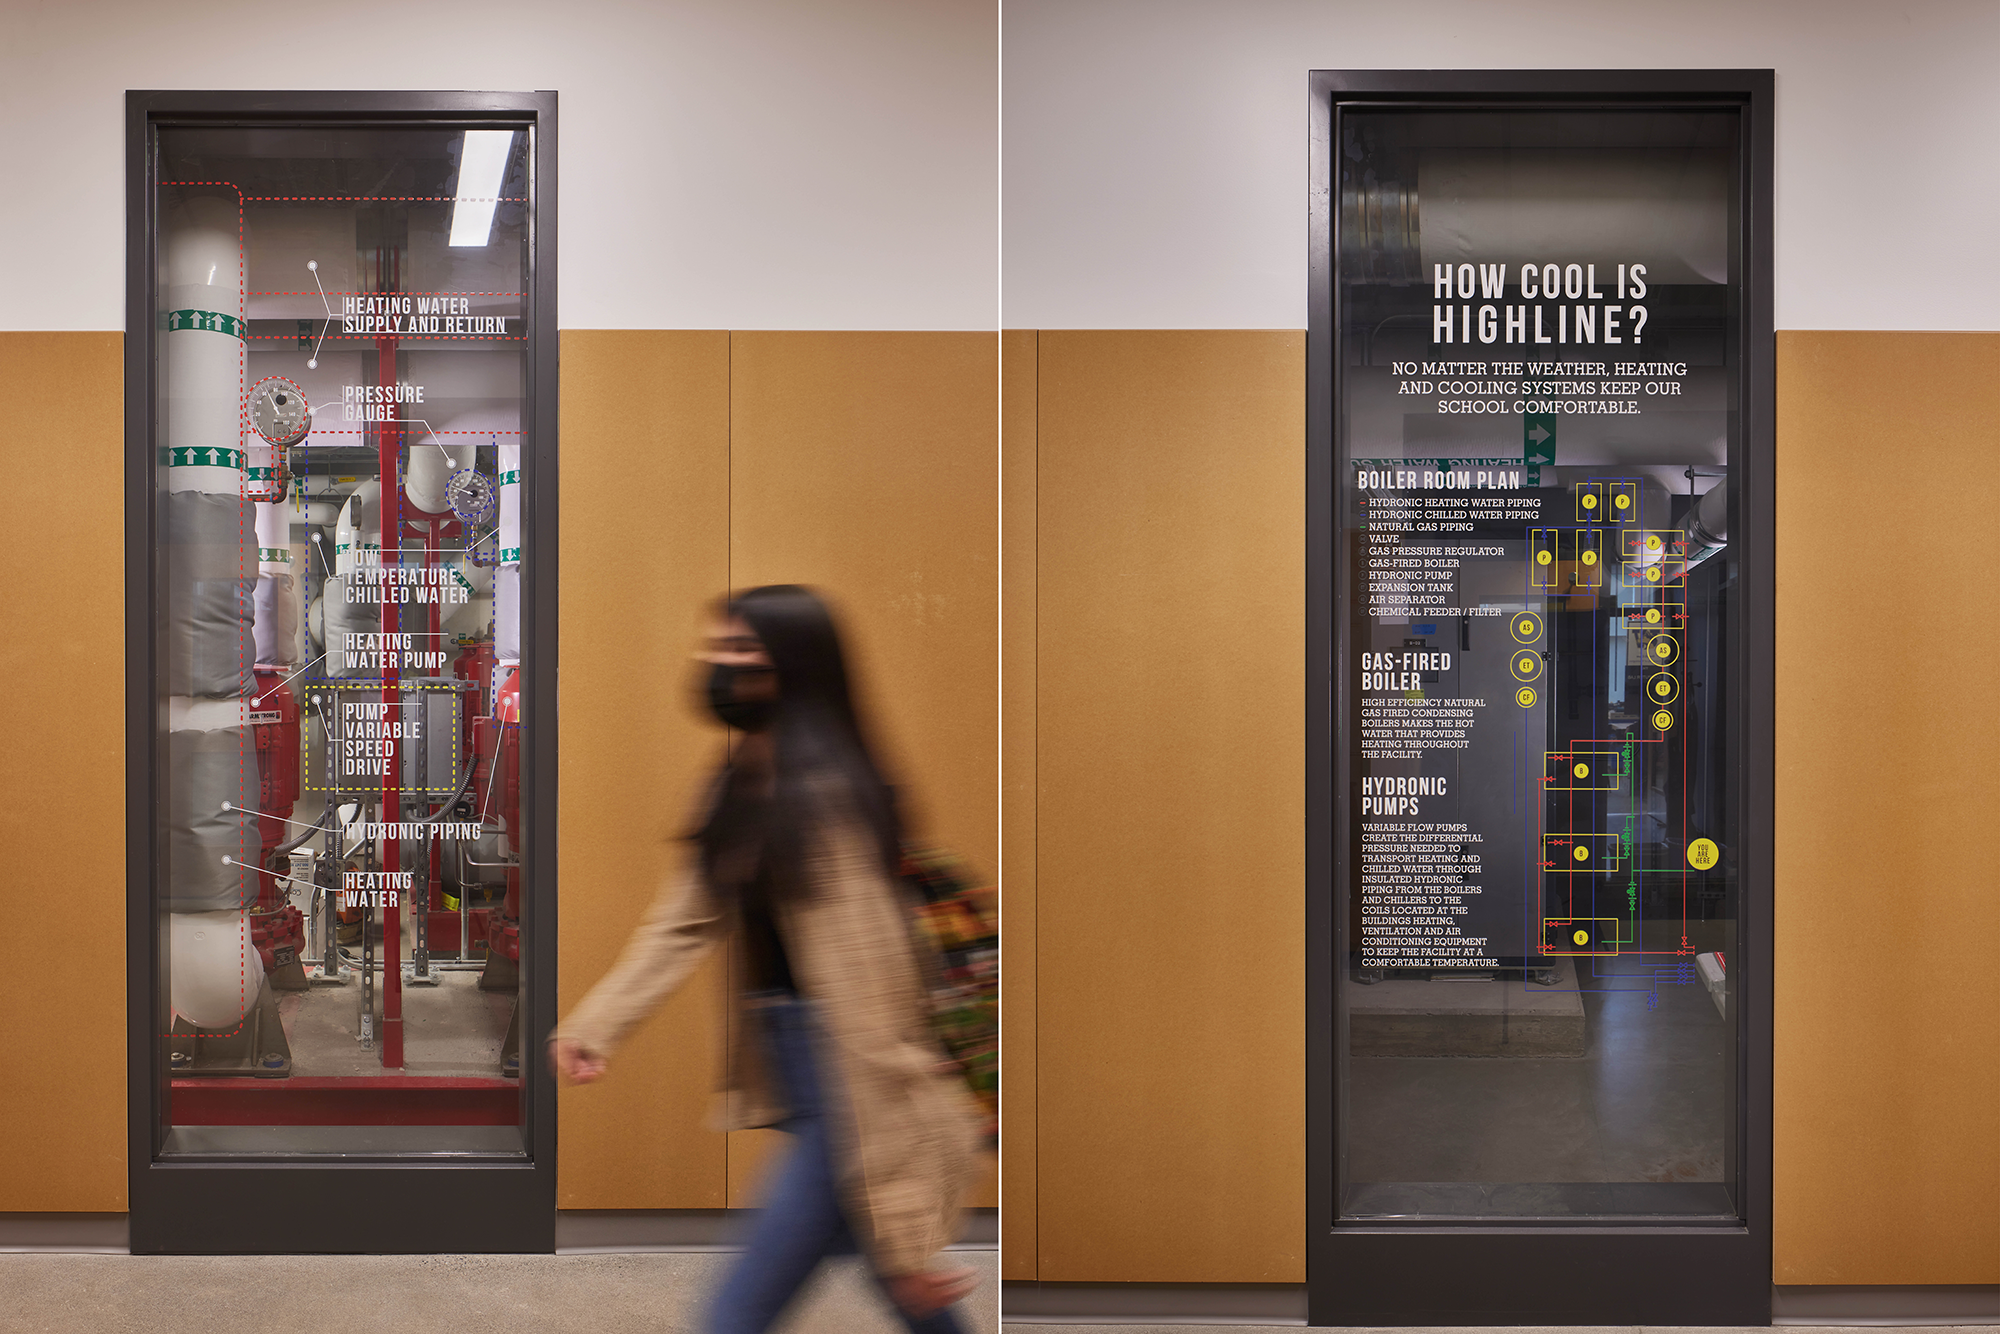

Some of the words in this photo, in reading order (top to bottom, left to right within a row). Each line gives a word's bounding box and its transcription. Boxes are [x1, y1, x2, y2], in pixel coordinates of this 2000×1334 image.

[1435, 264, 1506, 298] HOW
[1522, 264, 1602, 299] COOL
[1618, 264, 1646, 299] IS
[346, 297, 410, 314] HEATING
[418, 298, 468, 314] WATER
[346, 316, 403, 332] SUPPLY
[408, 317, 440, 332] AND
[446, 316, 506, 332] RETURN
[1434, 305, 1647, 343] HIGHLINE?
[1393, 362, 1417, 375] NO
[1422, 362, 1487, 375] MATTER
[1492, 363, 1523, 375] THE
[1527, 363, 1609, 376] WEATHER,
[1615, 363, 1687, 375] HEATING
[346, 386, 425, 403] PRESSURE
[1399, 381, 1433, 394] AND
[1438, 381, 1517, 394] COOLING
[1522, 382, 1595, 394] SYSTEMS
[1601, 382, 1640, 394] KEEP
[1646, 382, 1681, 394] OUR
[345, 405, 395, 421] GAUGE
[1439, 401, 1508, 413] SCHOOL
[1514, 401, 1640, 413] COMFORTABLE.
[1359, 471, 1416, 489] BOILER
[1424, 471, 1470, 489] ROOM
[1477, 471, 1519, 489] PLAN
[1369, 498, 1422, 507] HYDRONIC
[1425, 499, 1468, 507] HEATING
[1471, 499, 1504, 507] WATER
[1508, 499, 1541, 507] PIPING
[1369, 510, 1422, 520] HYDRONIC
[1425, 511, 1466, 519] CHILLED
[1469, 511, 1502, 519] WATER
[1506, 511, 1539, 519] PIPING
[1369, 522, 1414, 531] NATURAL
[1417, 523, 1437, 531] GAS
[1440, 523, 1473, 531] PIPING
[1369, 535, 1399, 543] VALVE
[1369, 547, 1389, 555] GAS
[1393, 547, 1442, 555] PRESSURE
[1445, 547, 1504, 555] REGULATOR
[346, 551, 378, 566] OW
[1369, 559, 1422, 567] GAS-FIRED
[1425, 559, 1459, 567] BOILER
[345, 569, 457, 585] TEMPERATURE
[1369, 571, 1422, 579] HYDRONIC
[1425, 571, 1452, 579] PUMP
[1369, 583, 1425, 592] EXPANSION
[346, 588, 408, 603] CHILLED
[416, 588, 467, 603] WATER
[1369, 595, 1385, 603] AIR
[1388, 595, 1445, 604] SEPARATOR
[1369, 607, 1421, 616] CHEMICAL
[1424, 608, 1461, 616] FEEDER
[1469, 606, 1503, 616] FILTER
[346, 635, 411, 650] HEATING
[346, 652, 397, 668] WATER
[405, 652, 446, 668] PUMP
[1363, 653, 1450, 670] GAS-FIRED
[1363, 672, 1420, 690] BOILER
[346, 705, 388, 720] PUMP
[1412, 709, 1473, 717] CONDENSING
[346, 722, 420, 738] VARIABLE
[1362, 719, 1400, 727] BOILERS
[1421, 730, 1465, 738] PROVIDES
[346, 741, 393, 756] SPEED
[1362, 740, 1402, 748] HEATING
[1404, 740, 1469, 748] THROUGHOUT
[347, 759, 390, 775] DRIVE
[1363, 777, 1446, 795] HYDRONIC
[1363, 797, 1418, 815] PUMPS
[345, 824, 424, 840] HYDRONIC
[430, 824, 482, 840] PIPING
[1419, 834, 1483, 842] DIFFERENTIAL
[1363, 844, 1408, 852] PRESSURE
[1403, 865, 1433, 873] WATER
[1436, 865, 1481, 873] THROUGH
[346, 873, 412, 888] HEATING
[346, 891, 397, 907] WATER
[1384, 896, 1427, 904] CHILLERS
[1429, 896, 1441, 904] TO
[1413, 917, 1455, 925] HEATING,
[1362, 927, 1421, 935] VENTILATION
[1434, 938, 1487, 946] EQUIPMENT
